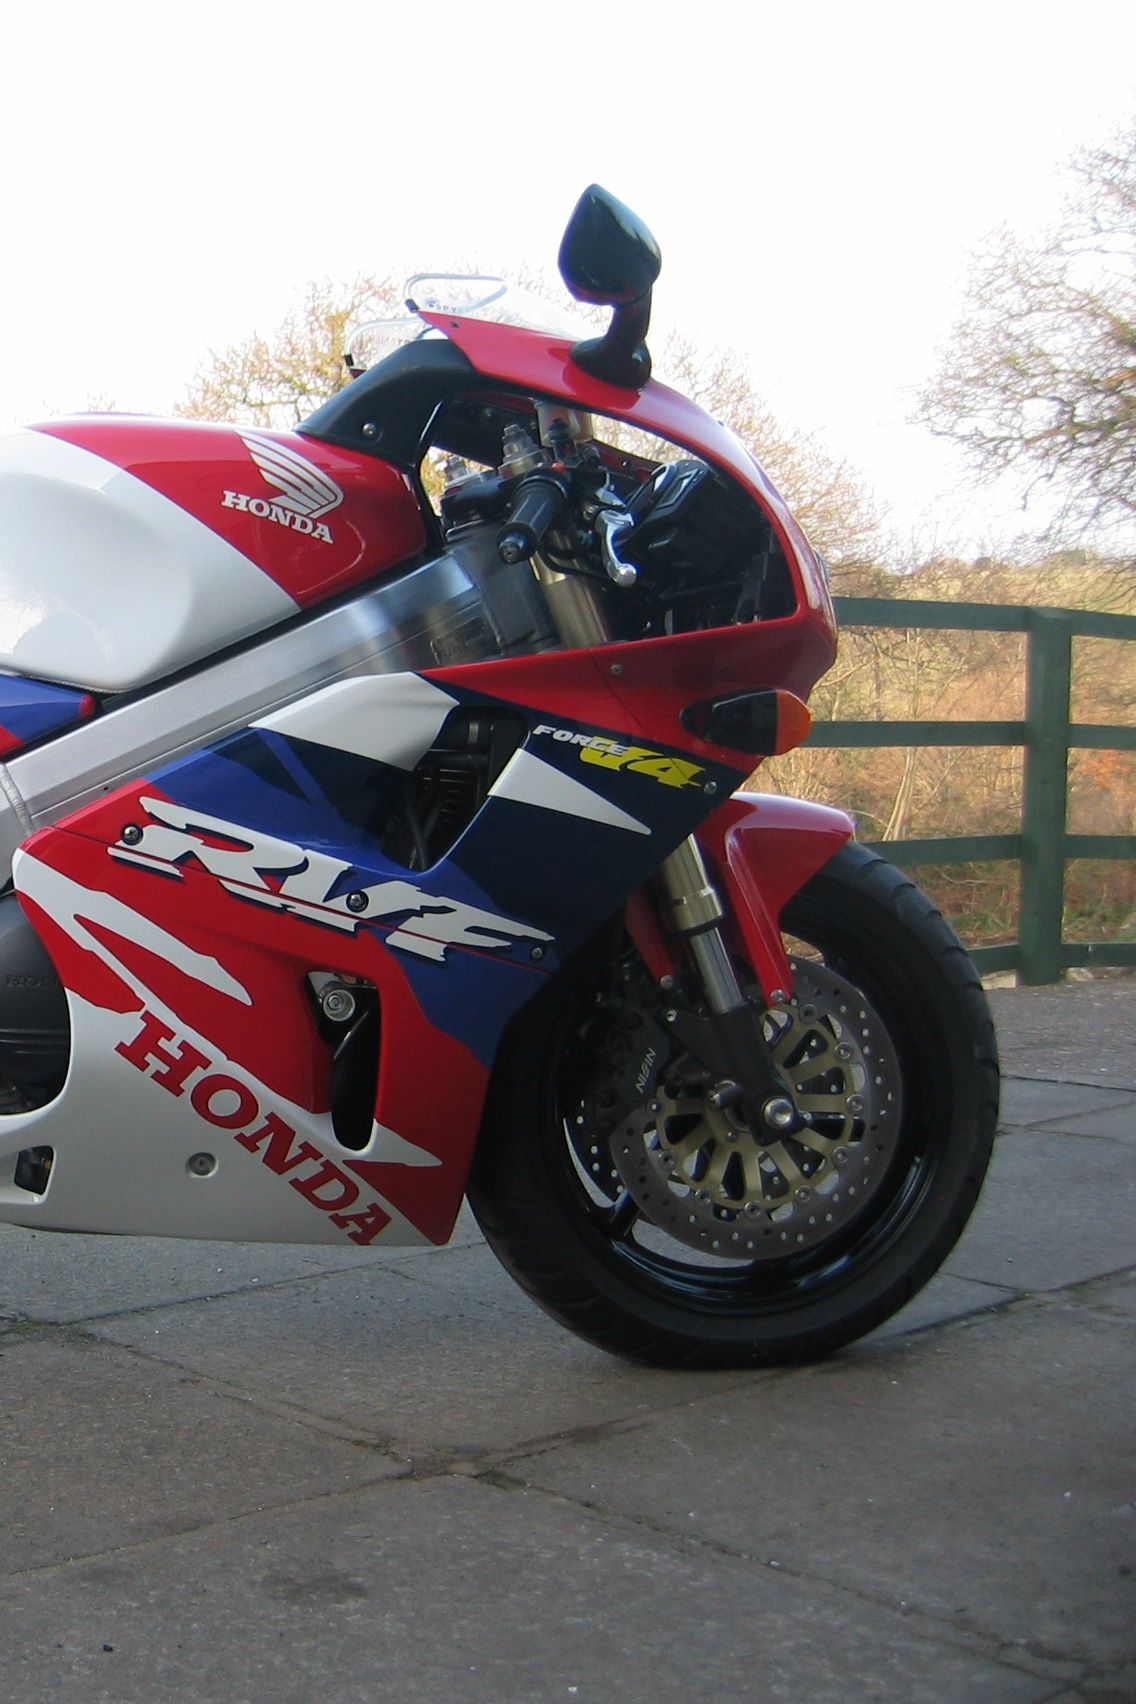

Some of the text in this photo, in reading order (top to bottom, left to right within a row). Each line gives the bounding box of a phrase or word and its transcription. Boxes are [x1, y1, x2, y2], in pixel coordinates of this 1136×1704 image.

[221, 490, 334, 544] HONDA
[532, 724, 629, 757] FORCE
[114, 1010, 393, 1246] HONDA
